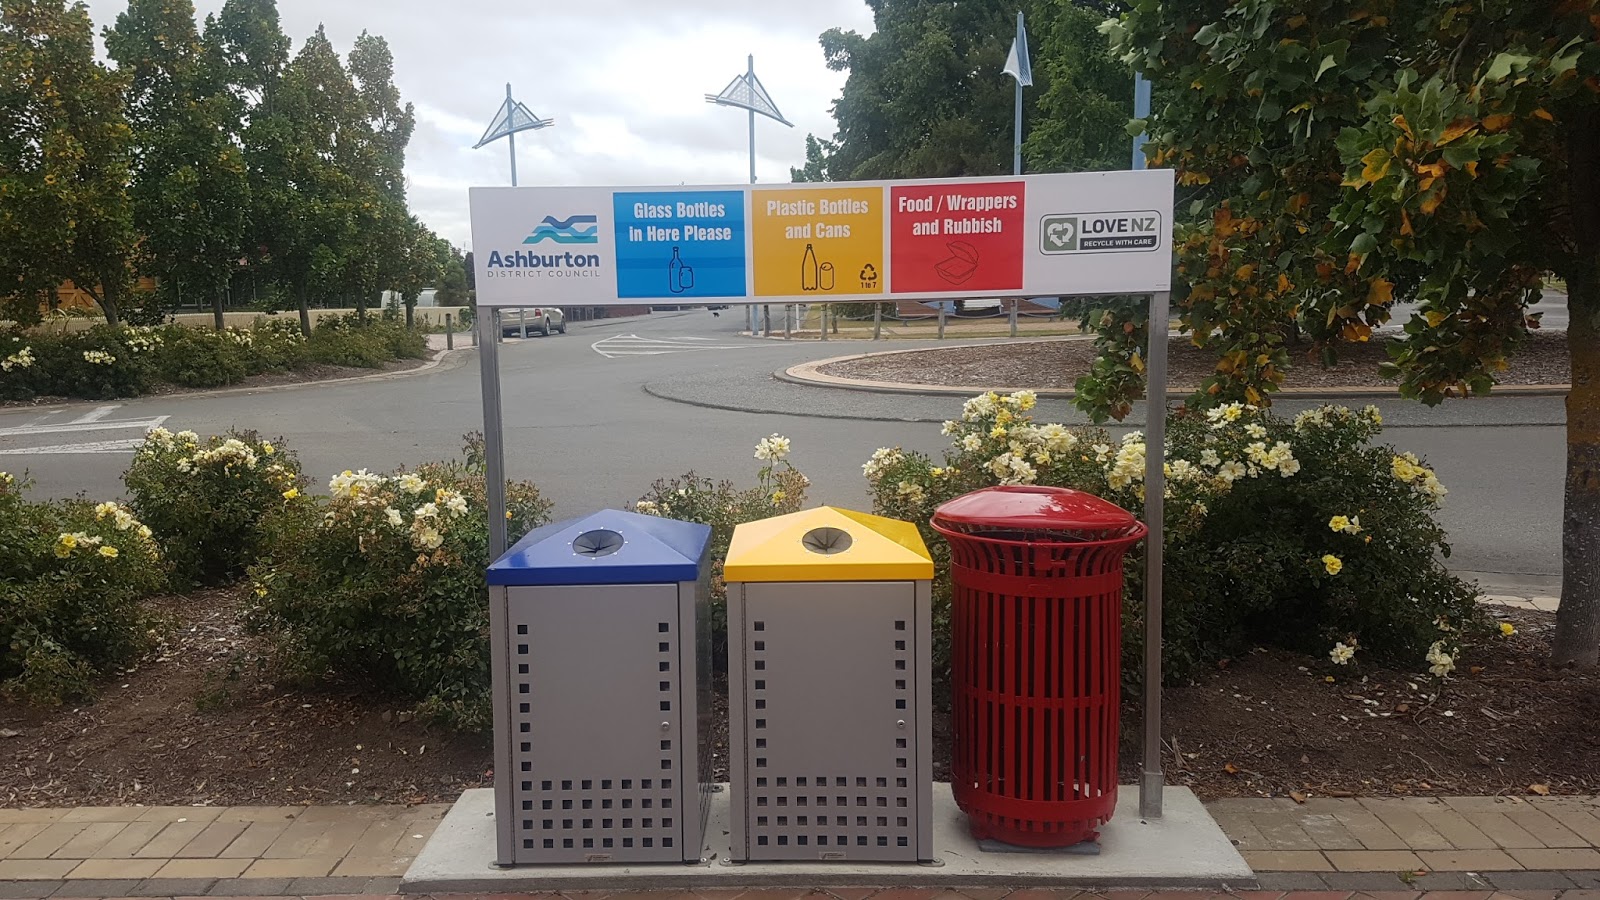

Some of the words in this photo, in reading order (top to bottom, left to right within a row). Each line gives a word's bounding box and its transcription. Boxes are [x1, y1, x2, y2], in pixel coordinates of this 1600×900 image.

[633, 202, 672, 219] Glass
[676, 202, 725, 218] Bottles
[767, 200, 815, 216] Plastic
[819, 198, 869, 215] Bottles
[898, 196, 933, 213] Food
[947, 193, 1017, 212] Wrappers
[629, 226, 643, 242] in
[647, 225, 680, 242] Here
[684, 225, 732, 241] Please
[785, 223, 811, 240] and
[815, 222, 851, 239] Cans
[912, 219, 939, 236] and
[943, 217, 1002, 236] Rubbish
[1082, 218, 1128, 234] LOVE
[1131, 217, 1156, 233] NZ
[1083, 240, 1114, 248] RECYCLE
[1115, 239, 1133, 247] WITH
[1133, 238, 1153, 246] CARE
[487, 250, 600, 268] Ashburton
[487, 270, 542, 278] DISTRICT
[548, 270, 600, 278] COUNCIL
